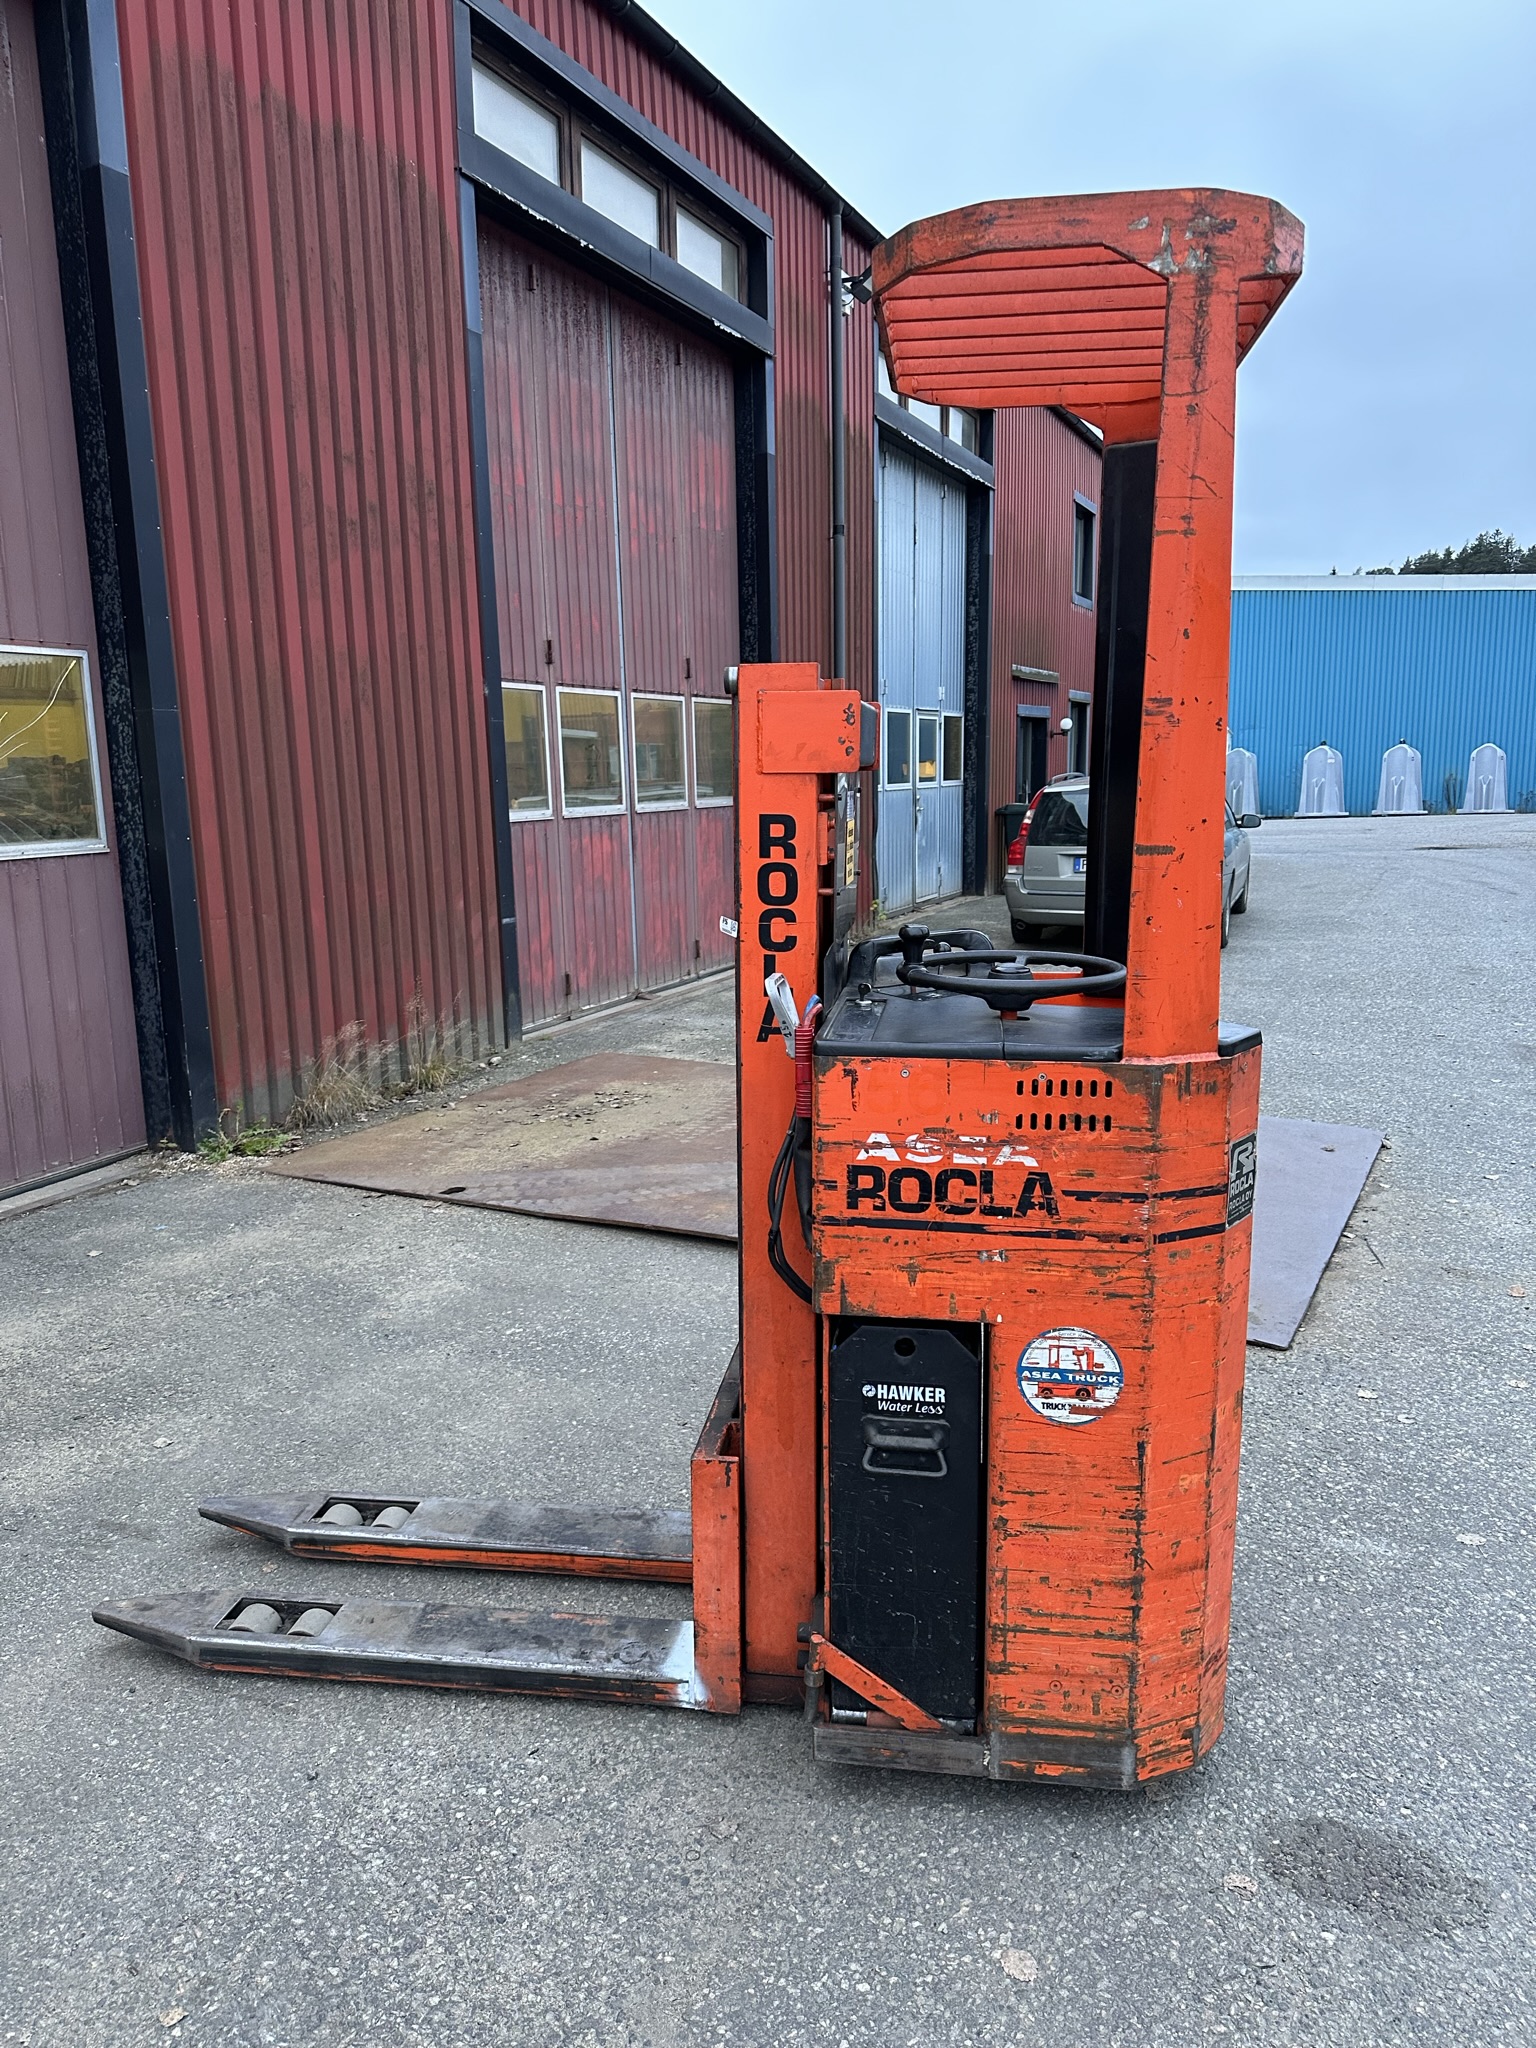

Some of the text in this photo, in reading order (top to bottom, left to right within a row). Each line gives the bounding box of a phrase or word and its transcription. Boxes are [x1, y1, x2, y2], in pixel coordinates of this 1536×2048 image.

[856, 1132, 1040, 1167] ASEA
[846, 1164, 1061, 1219] ROCLA
[1230, 1172, 1254, 1197] ROCLA
[1021, 1370, 1120, 1384] ASEA TRUCK
[877, 1384, 946, 1403] HAWKER
[878, 1400, 944, 1415] Water Less
